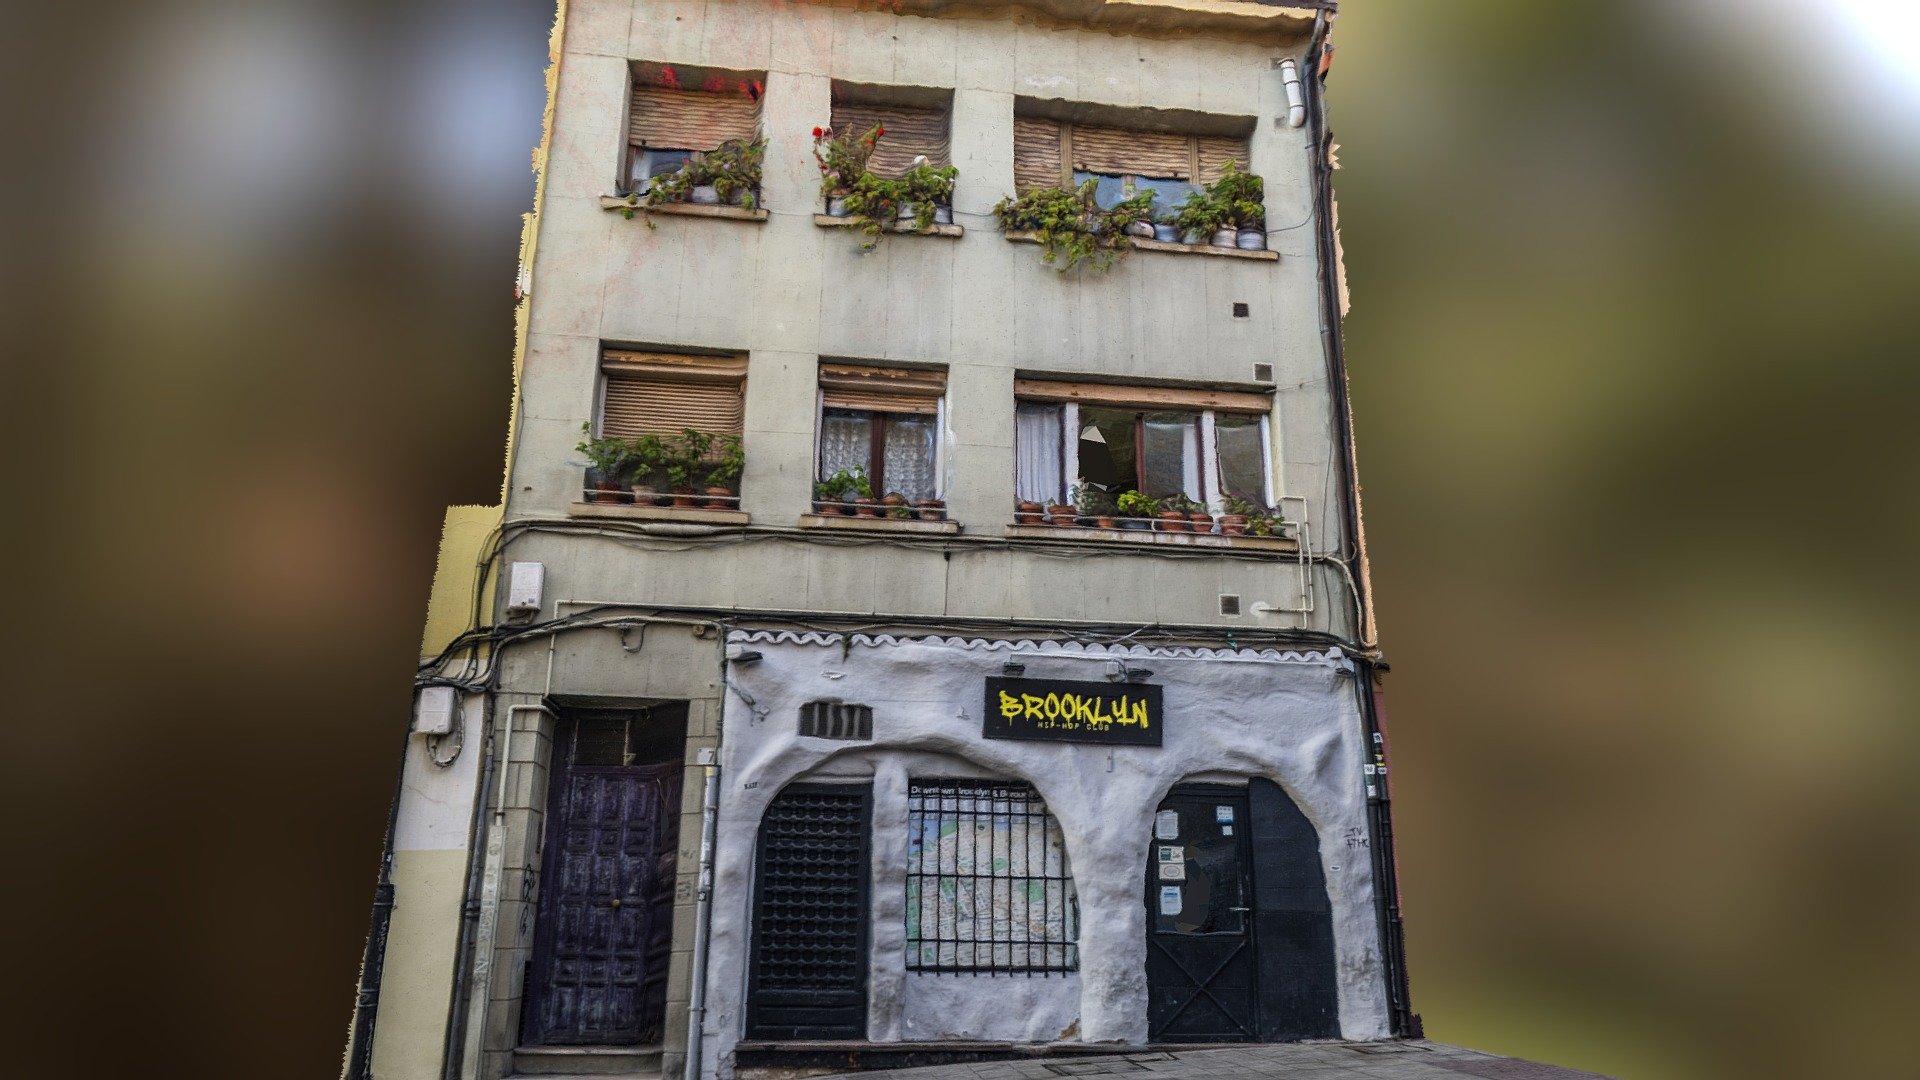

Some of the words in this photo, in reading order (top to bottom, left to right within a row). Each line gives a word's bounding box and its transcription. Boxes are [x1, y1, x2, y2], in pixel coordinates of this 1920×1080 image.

[999, 690, 1148, 729] BROOKLYN
[1037, 721, 1080, 730] HIP-HOP
[1086, 723, 1110, 731] CLUB
